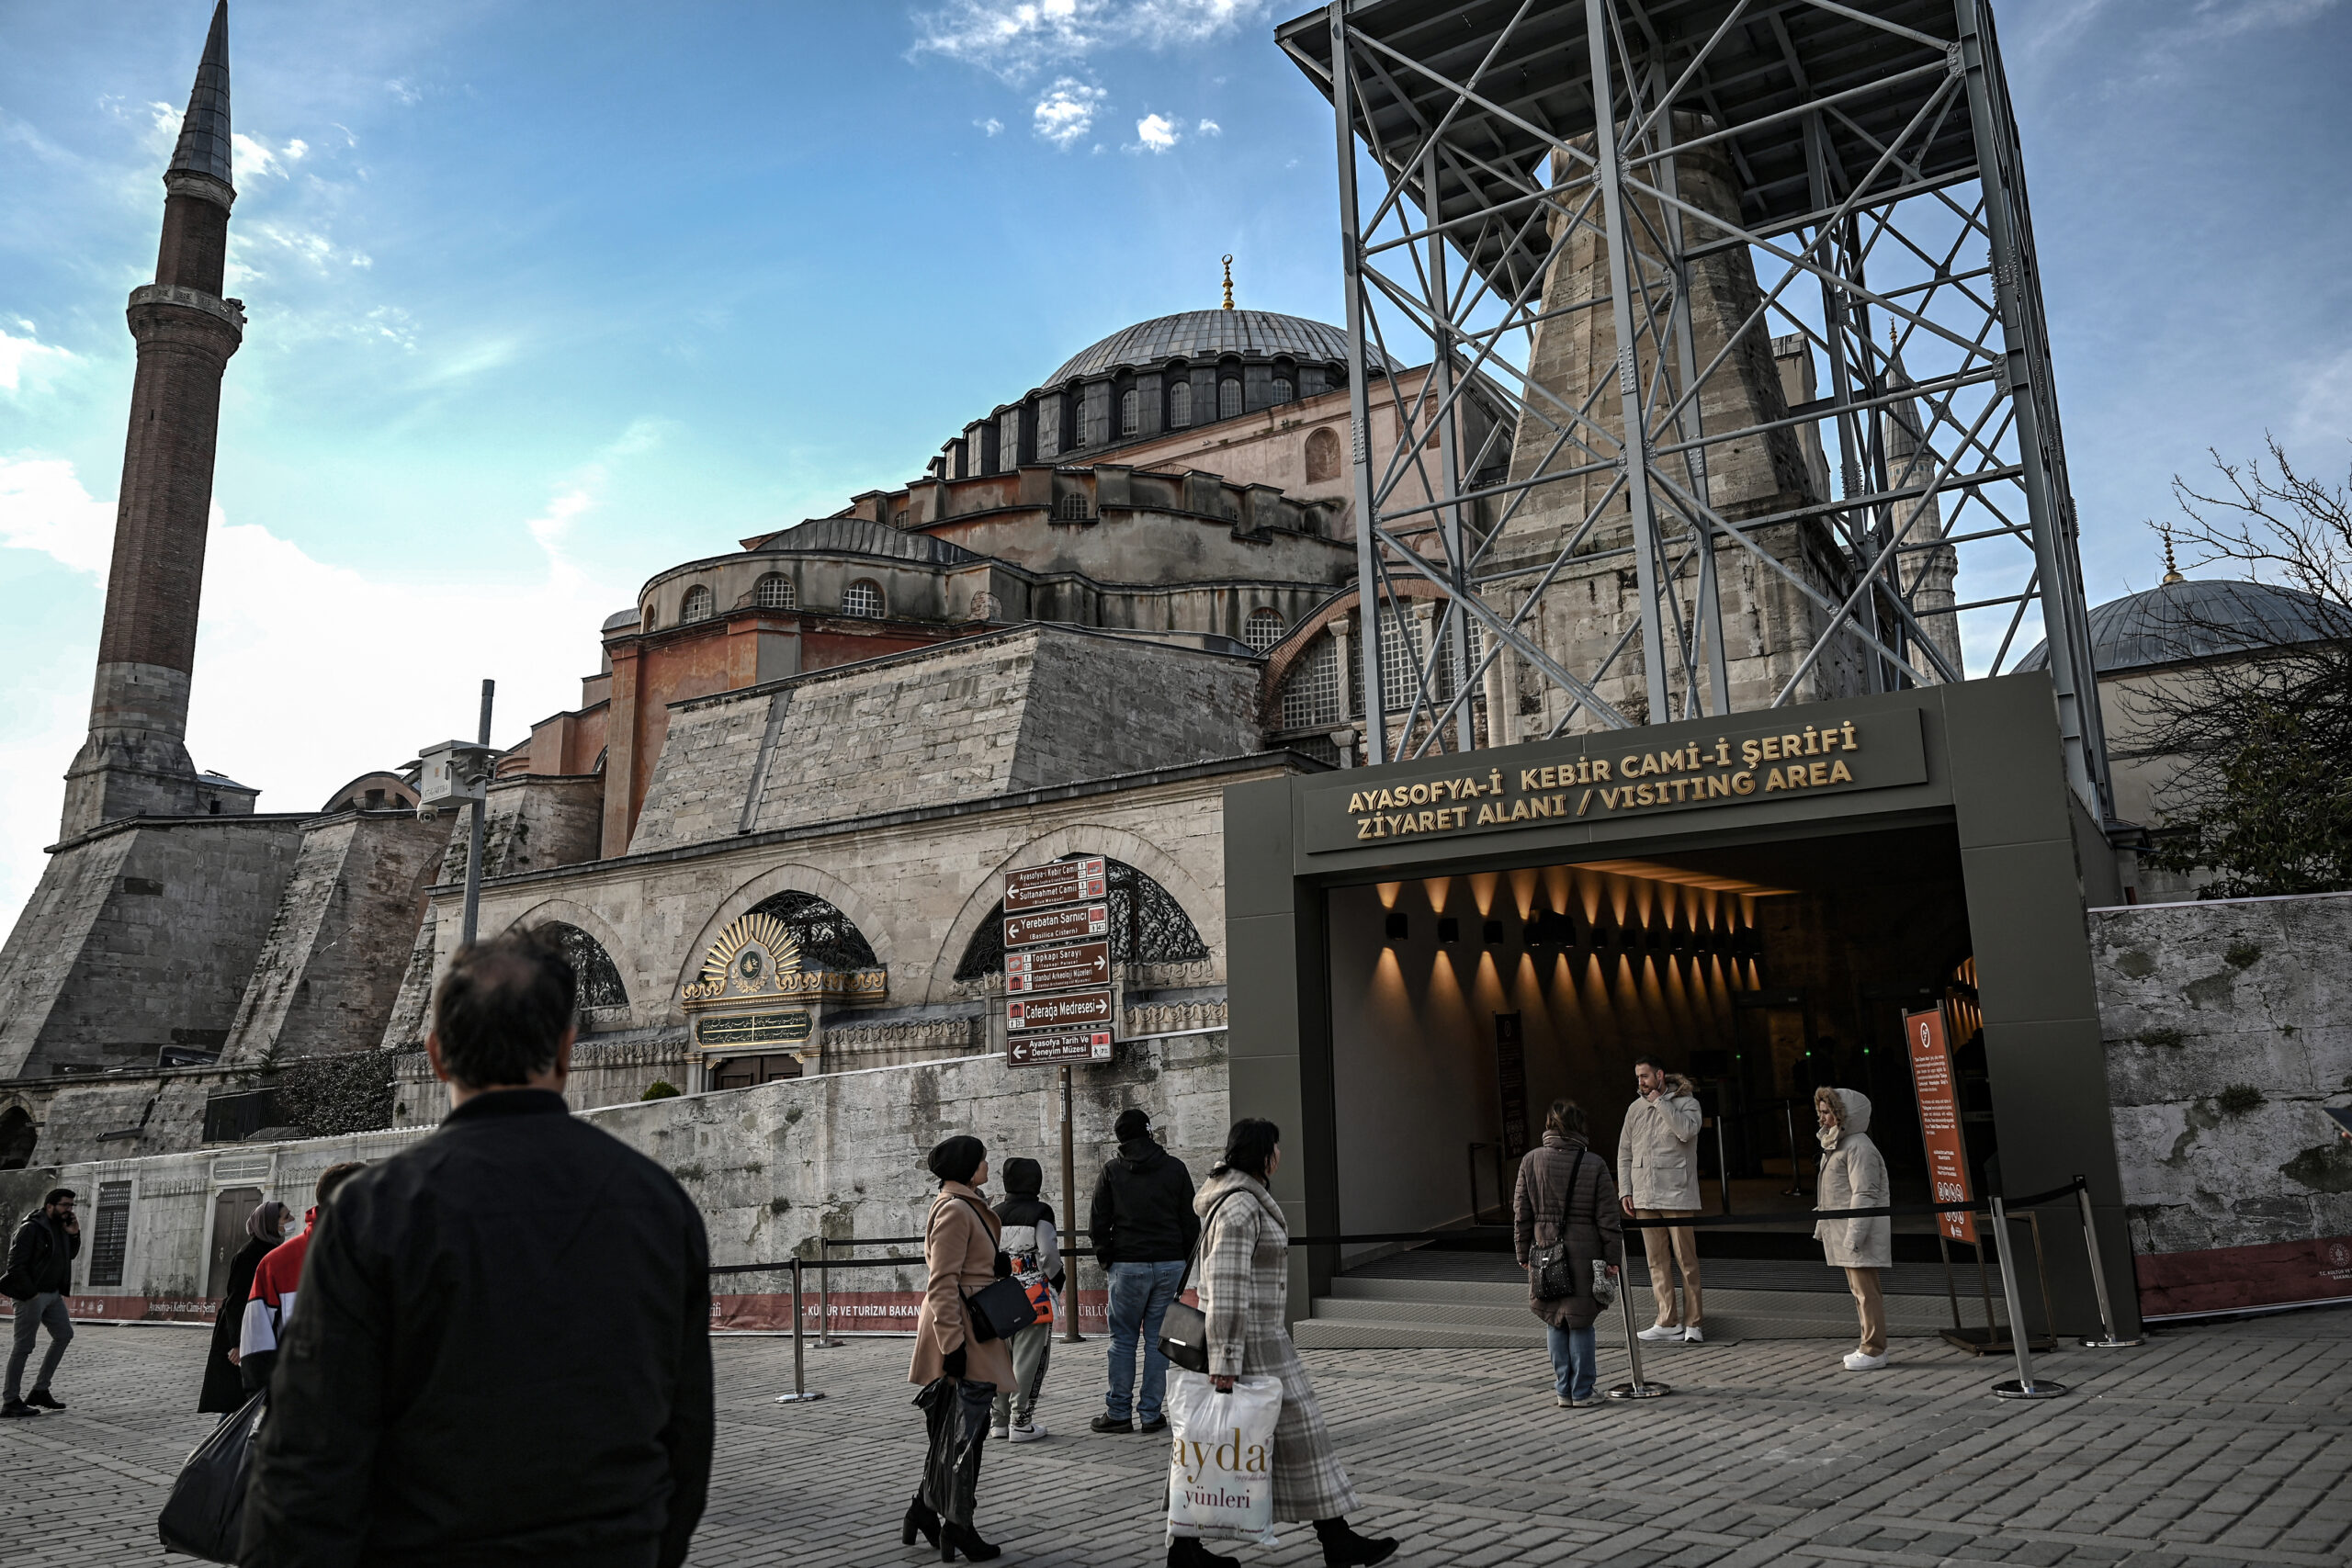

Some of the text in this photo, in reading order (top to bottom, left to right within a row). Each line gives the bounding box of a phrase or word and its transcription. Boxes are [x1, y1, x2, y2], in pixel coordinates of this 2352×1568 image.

[1347, 719, 1859, 814] AYASOFYA-İ KEBİR CAMİ-İ ŞERİFİ
[1357, 807, 1470, 840] ZİYARET
[1476, 794, 1567, 825] ALANI
[1600, 771, 1757, 812] VISITING
[1765, 759, 1854, 792] AREA
[1020, 884, 1078, 900] Sultanahmet Camii
[1020, 911, 1087, 930] Yerebatan Sarnıcı
[1033, 953, 1058, 963] Topkapı
[1025, 998, 1095, 1021] Caferağa Medresesi
[1029, 1035, 1090, 1050] Ayasofya Tarih Ve
[1062, 1044, 1087, 1055] Müzesi
[808, 1303, 838, 1316] KÜÜR
[840, 1305, 851, 1316] VE
[853, 1303, 887, 1316] TURİZM
[889, 1305, 922, 1316] BAKAN
[1172, 1427, 1266, 1484] ayda
[1182, 1485, 1251, 1509] yünleri
